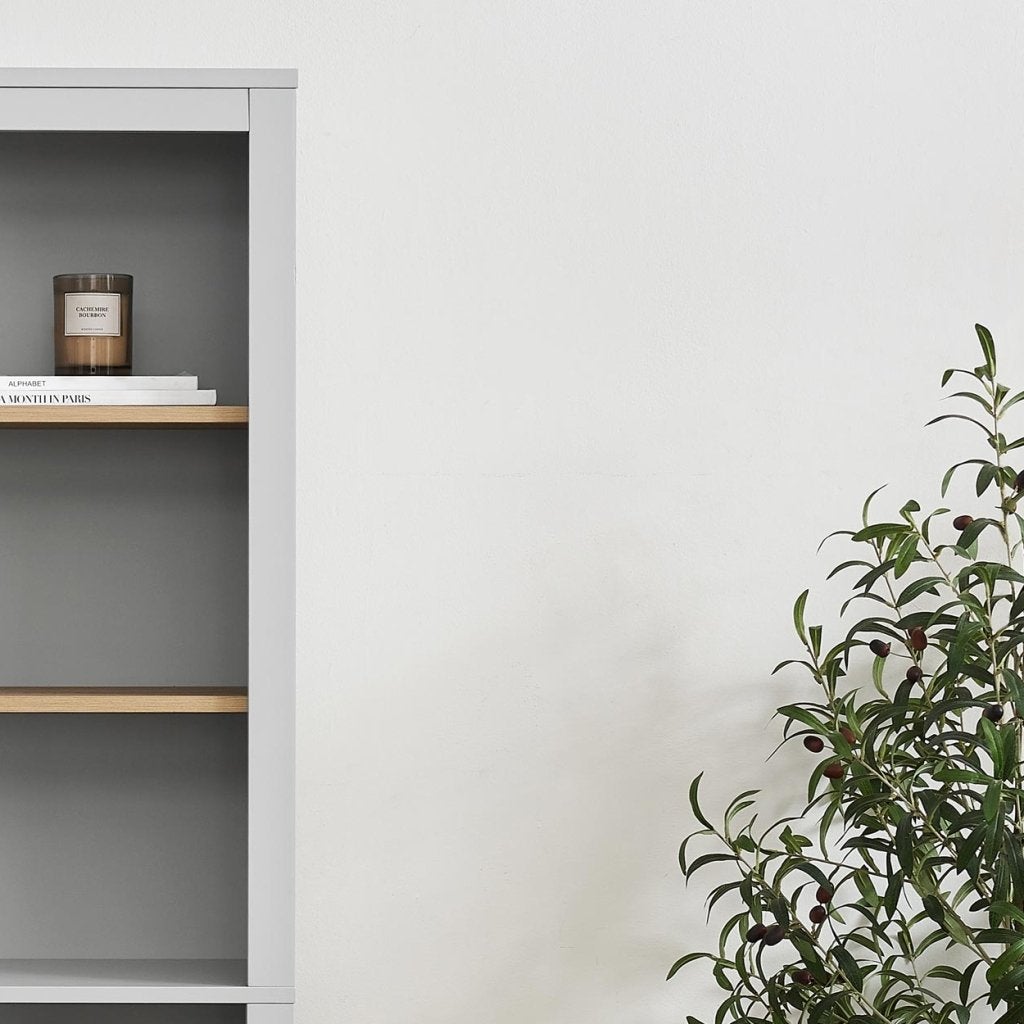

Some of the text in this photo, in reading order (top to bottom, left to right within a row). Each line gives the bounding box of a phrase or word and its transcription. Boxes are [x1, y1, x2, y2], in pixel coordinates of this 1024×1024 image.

[1, 394, 91, 404] A MONTH IN PARIS
